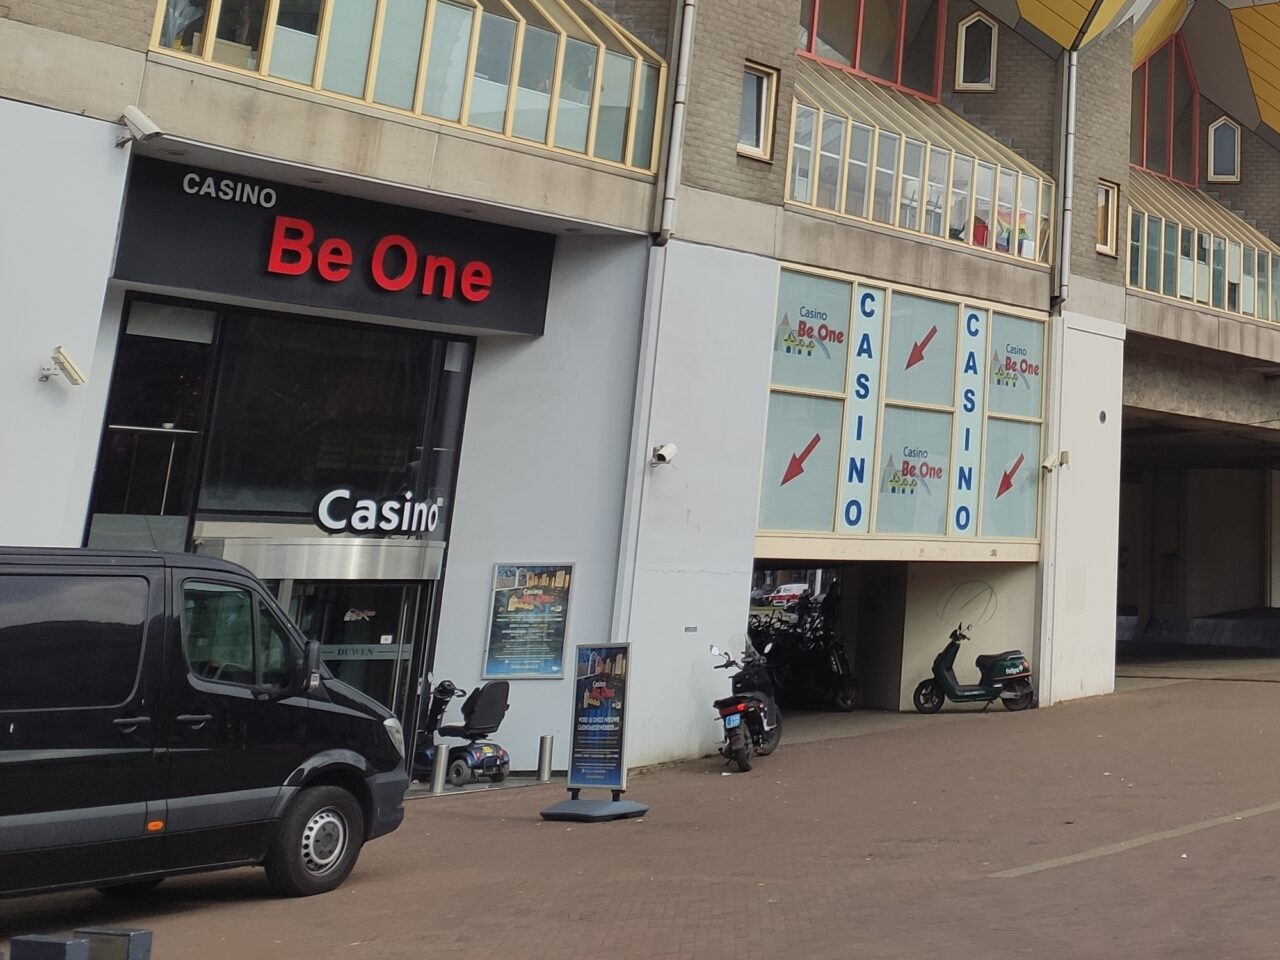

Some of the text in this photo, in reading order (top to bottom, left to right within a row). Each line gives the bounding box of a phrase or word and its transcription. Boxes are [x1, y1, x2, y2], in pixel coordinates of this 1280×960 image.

[182, 172, 277, 209] CASINO
[267, 215, 494, 303] Be One
[799, 306, 827, 321] Casino
[797, 320, 844, 344] Be One
[1006, 343, 1027, 356] Casino
[1005, 356, 1039, 376] Be One
[844, 292, 876, 527] CASINO
[954, 313, 980, 531] CASINO
[903, 446, 928, 459] Casino
[901, 459, 943, 480] Be One
[318, 489, 439, 533] Casino
[337, 648, 374, 656] DUWEN
